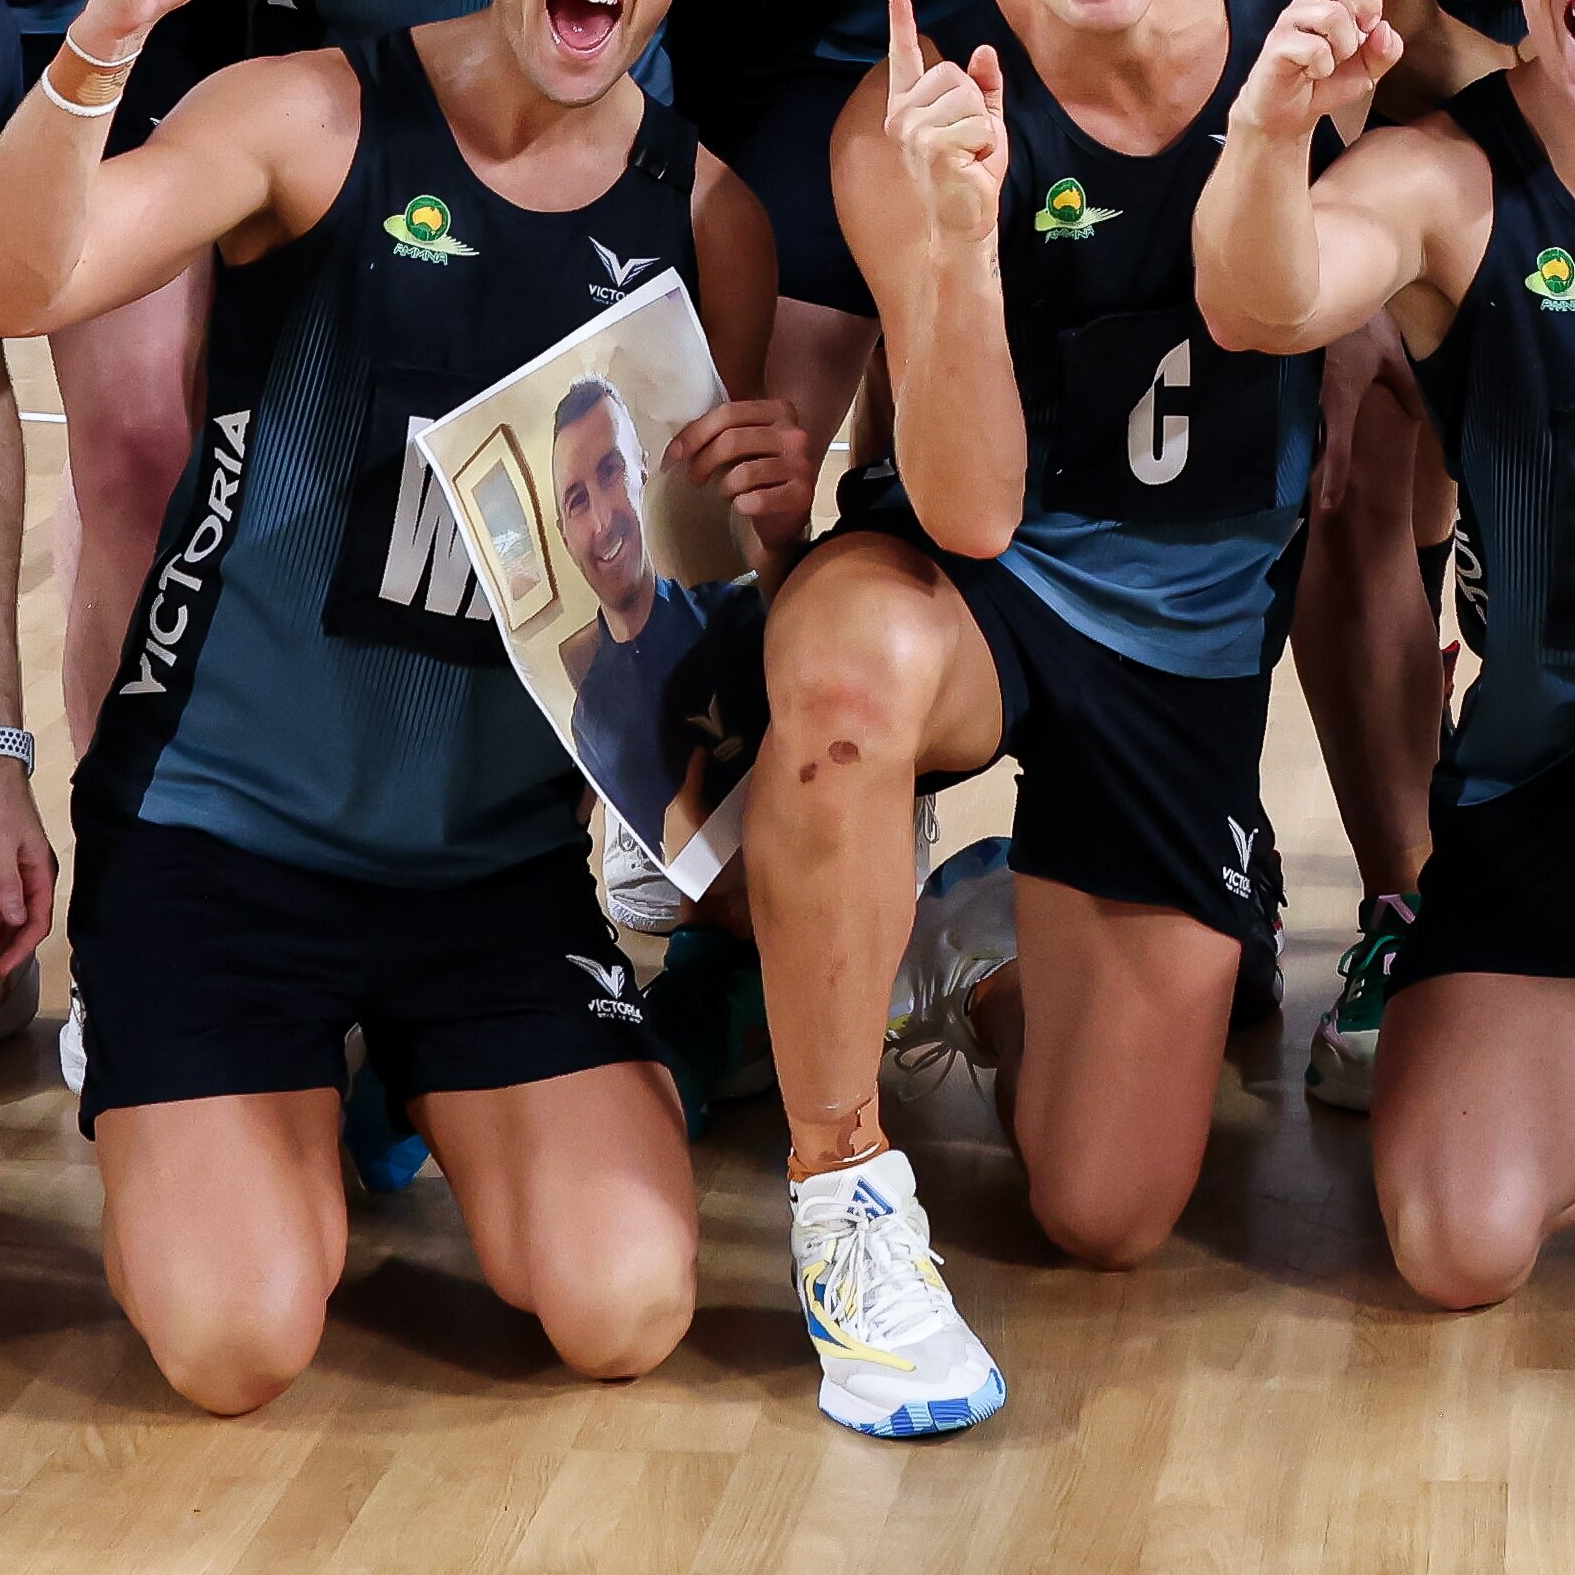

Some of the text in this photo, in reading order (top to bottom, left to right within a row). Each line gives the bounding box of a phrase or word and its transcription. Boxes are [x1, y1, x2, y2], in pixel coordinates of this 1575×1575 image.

[589, 284, 626, 302] VICTO
[119, 409, 251, 695] VICTORIA
[379, 416, 493, 621] W
